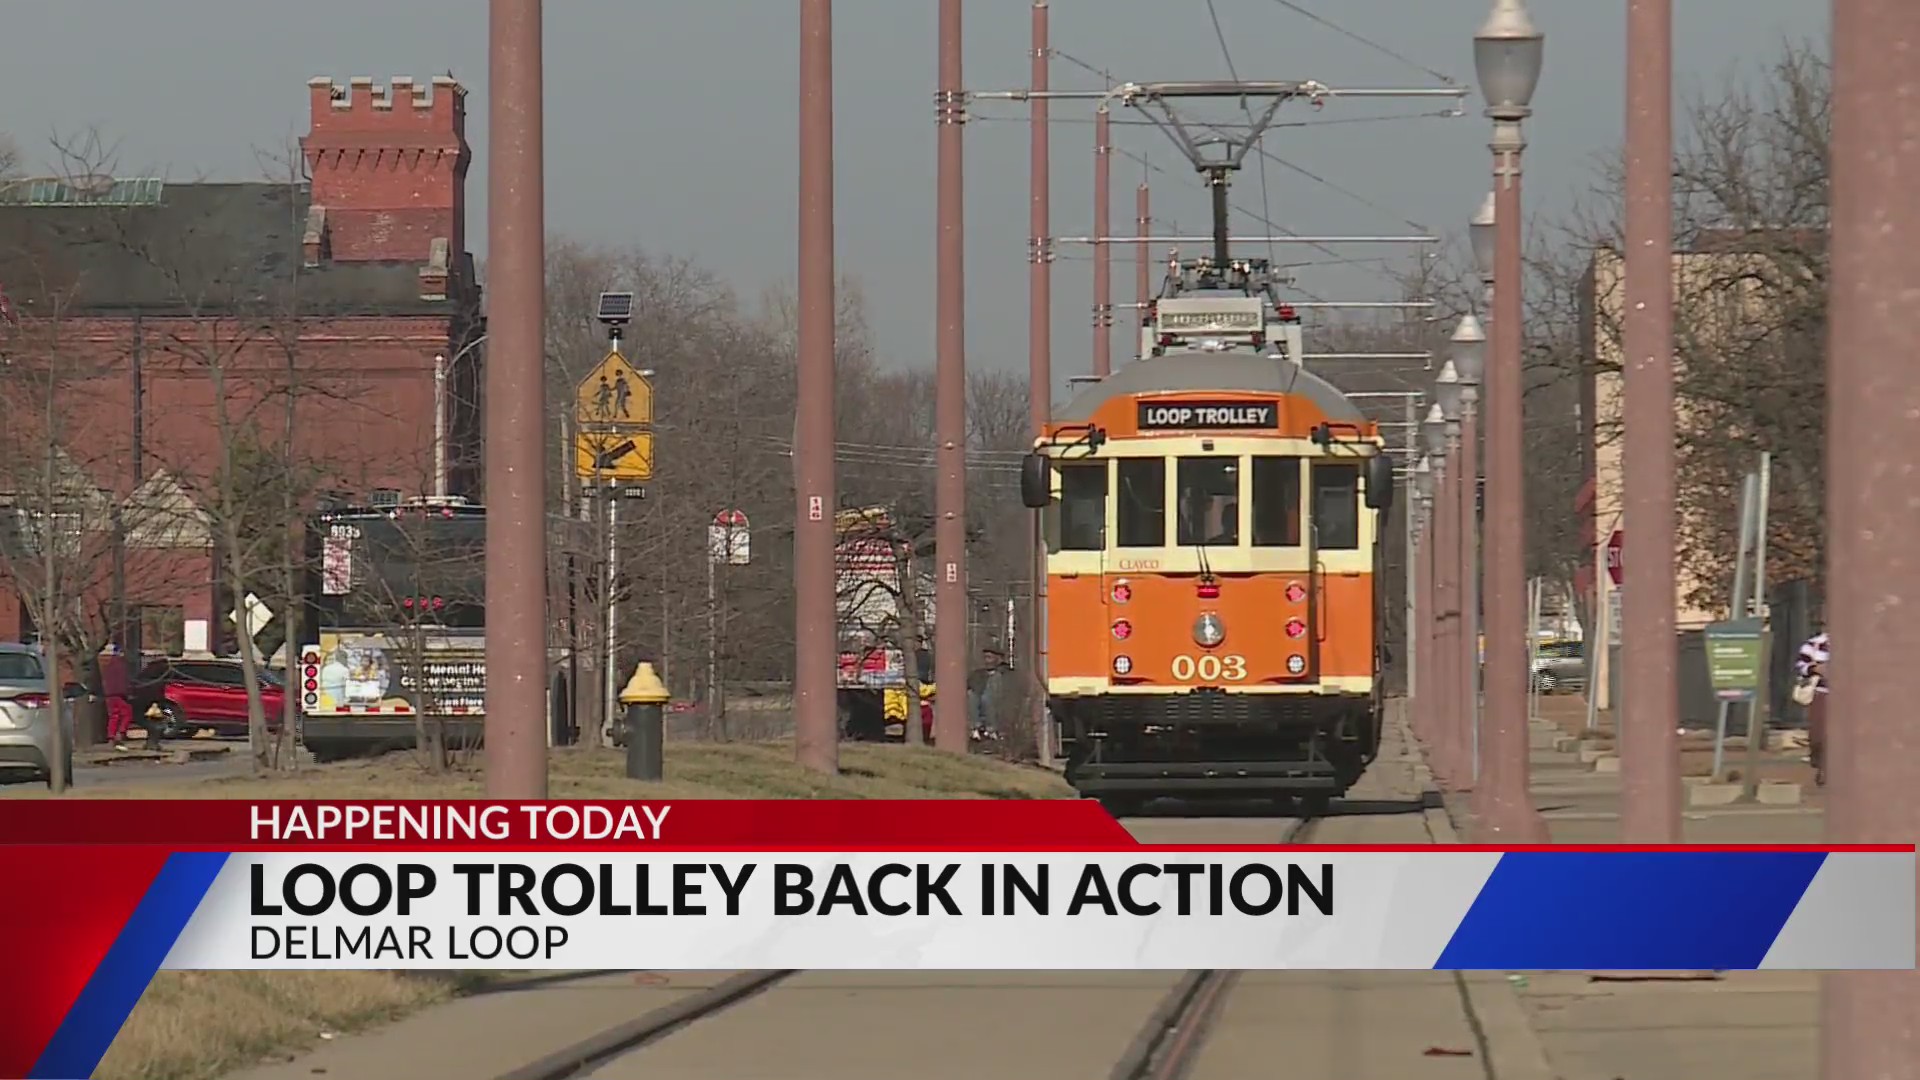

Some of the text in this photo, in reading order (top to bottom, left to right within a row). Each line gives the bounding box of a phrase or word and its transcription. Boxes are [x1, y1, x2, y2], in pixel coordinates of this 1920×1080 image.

[1147, 408, 1268, 424] LOOP TROLLEY
[1171, 655, 1247, 680] 003
